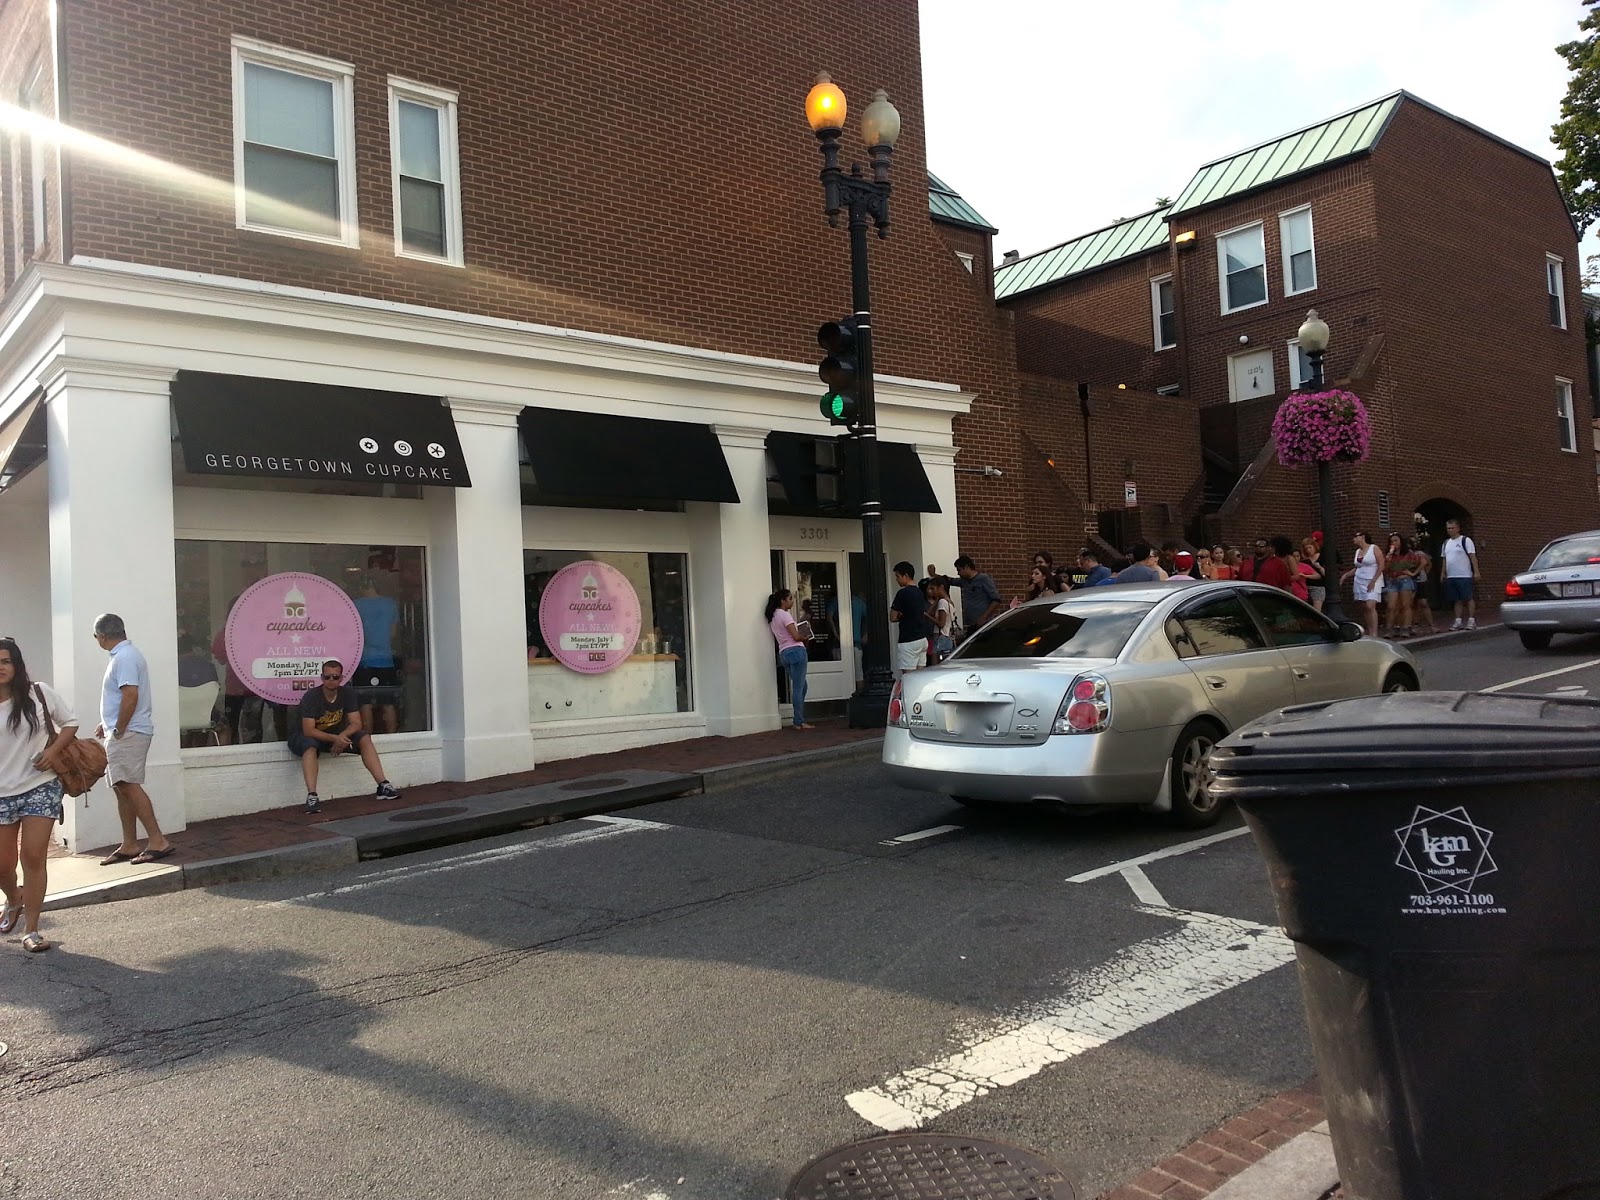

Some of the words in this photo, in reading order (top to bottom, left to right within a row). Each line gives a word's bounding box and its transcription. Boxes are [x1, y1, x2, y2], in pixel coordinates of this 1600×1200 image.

[205, 453, 352, 474] GEORGETOWN
[365, 462, 452, 480] CUPCAKE
[800, 527, 829, 540] 3301
[283, 606, 307, 618] DC
[569, 599, 613, 614] cupcakes
[266, 617, 326, 635] cupcakes
[267, 646, 290, 656] ALL
[294, 646, 326, 656] NEW!
[267, 662, 302, 670] Monday,
[303, 661, 319, 669] July
[273, 669, 292, 678] 7pm
[292, 680, 315, 690] TLC
[1410, 894, 1494, 906] 703-961-1100
[1401, 907, 1507, 915] www.kmghauling.com
